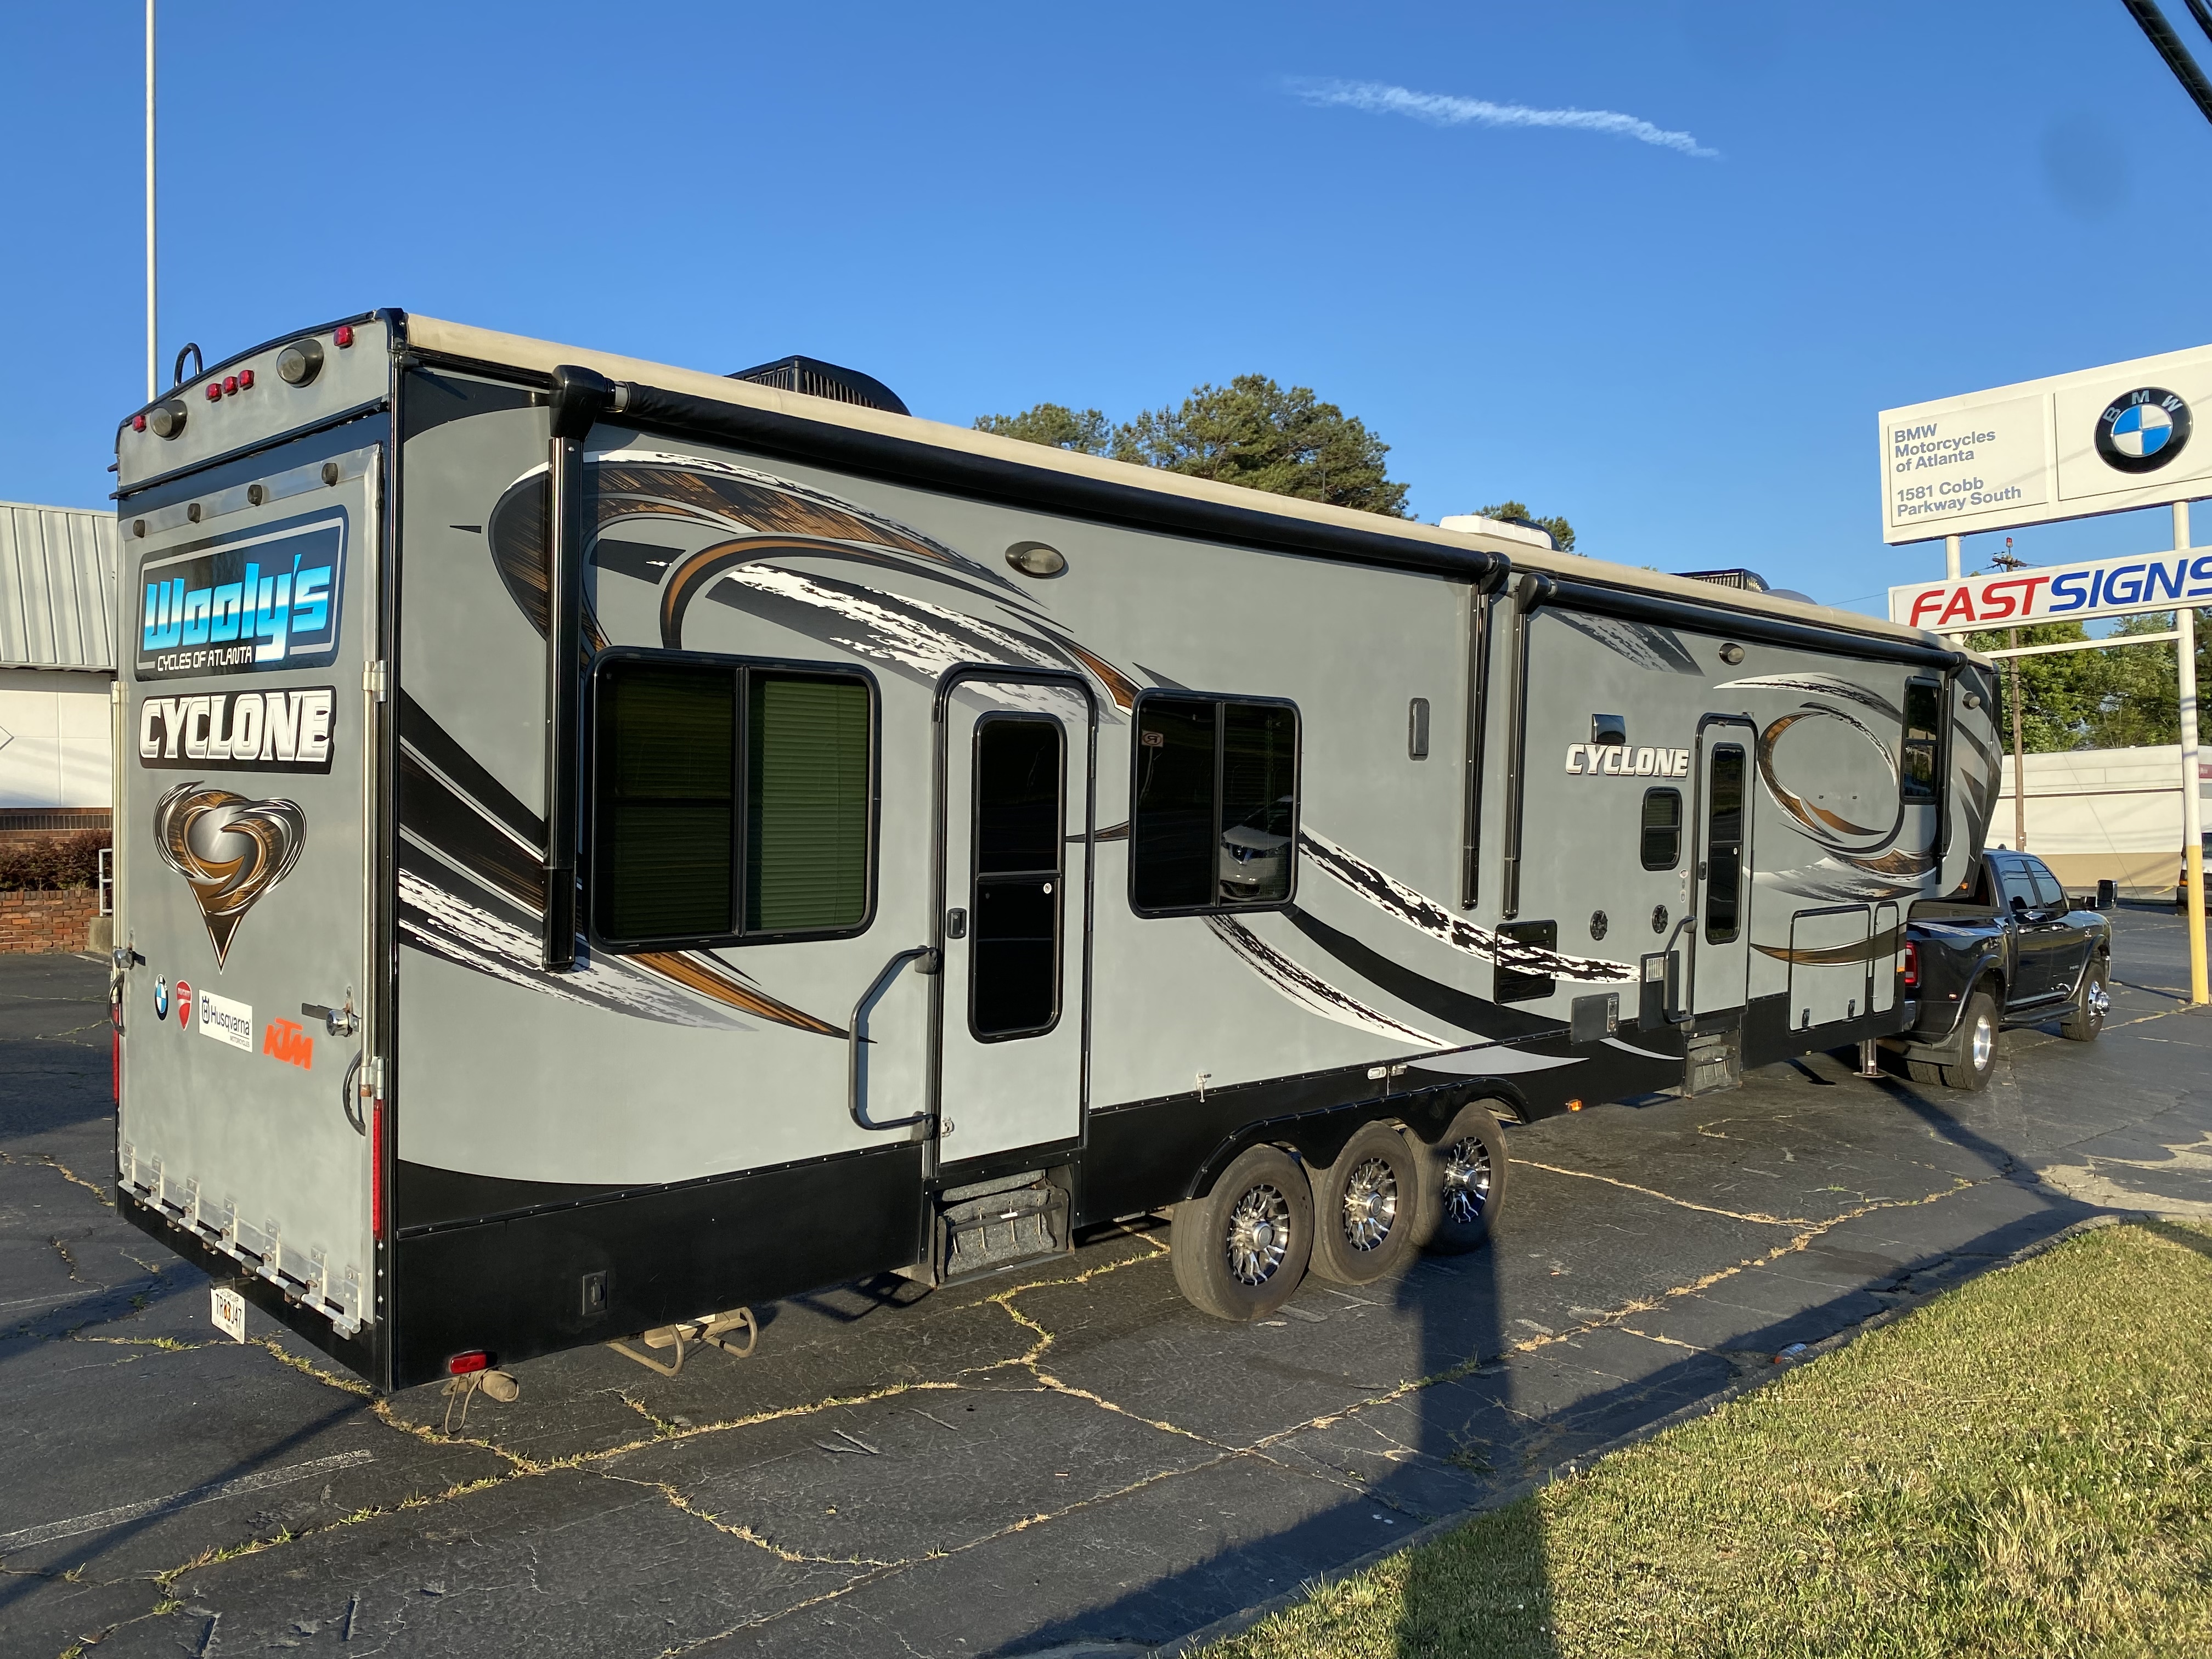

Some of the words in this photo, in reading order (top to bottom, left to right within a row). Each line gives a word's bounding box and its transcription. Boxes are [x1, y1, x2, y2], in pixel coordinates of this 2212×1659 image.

[2103, 390, 2183, 423] BMW
[1894, 423, 1937, 443] BMW
[1895, 431, 1996, 458] Motorcycles
[1896, 458, 1912, 472] of
[1915, 450, 1974, 470] Atlanta
[1897, 484, 1933, 502] 1581
[1939, 477, 1984, 495] Cobb
[1898, 497, 1967, 517] Parkway
[1971, 486, 2021, 505] South
[144, 554, 331, 663] Wooly's
[157, 652, 192, 672] CYCLES
[193, 651, 206, 668] OF
[207, 646, 252, 667] ATLANTA
[139, 689, 332, 763] CYCLONE
[1566, 743, 1689, 777] CYCLONE
[211, 1005, 250, 1036] Husqvarna
[263, 1017, 314, 1071] KTM
